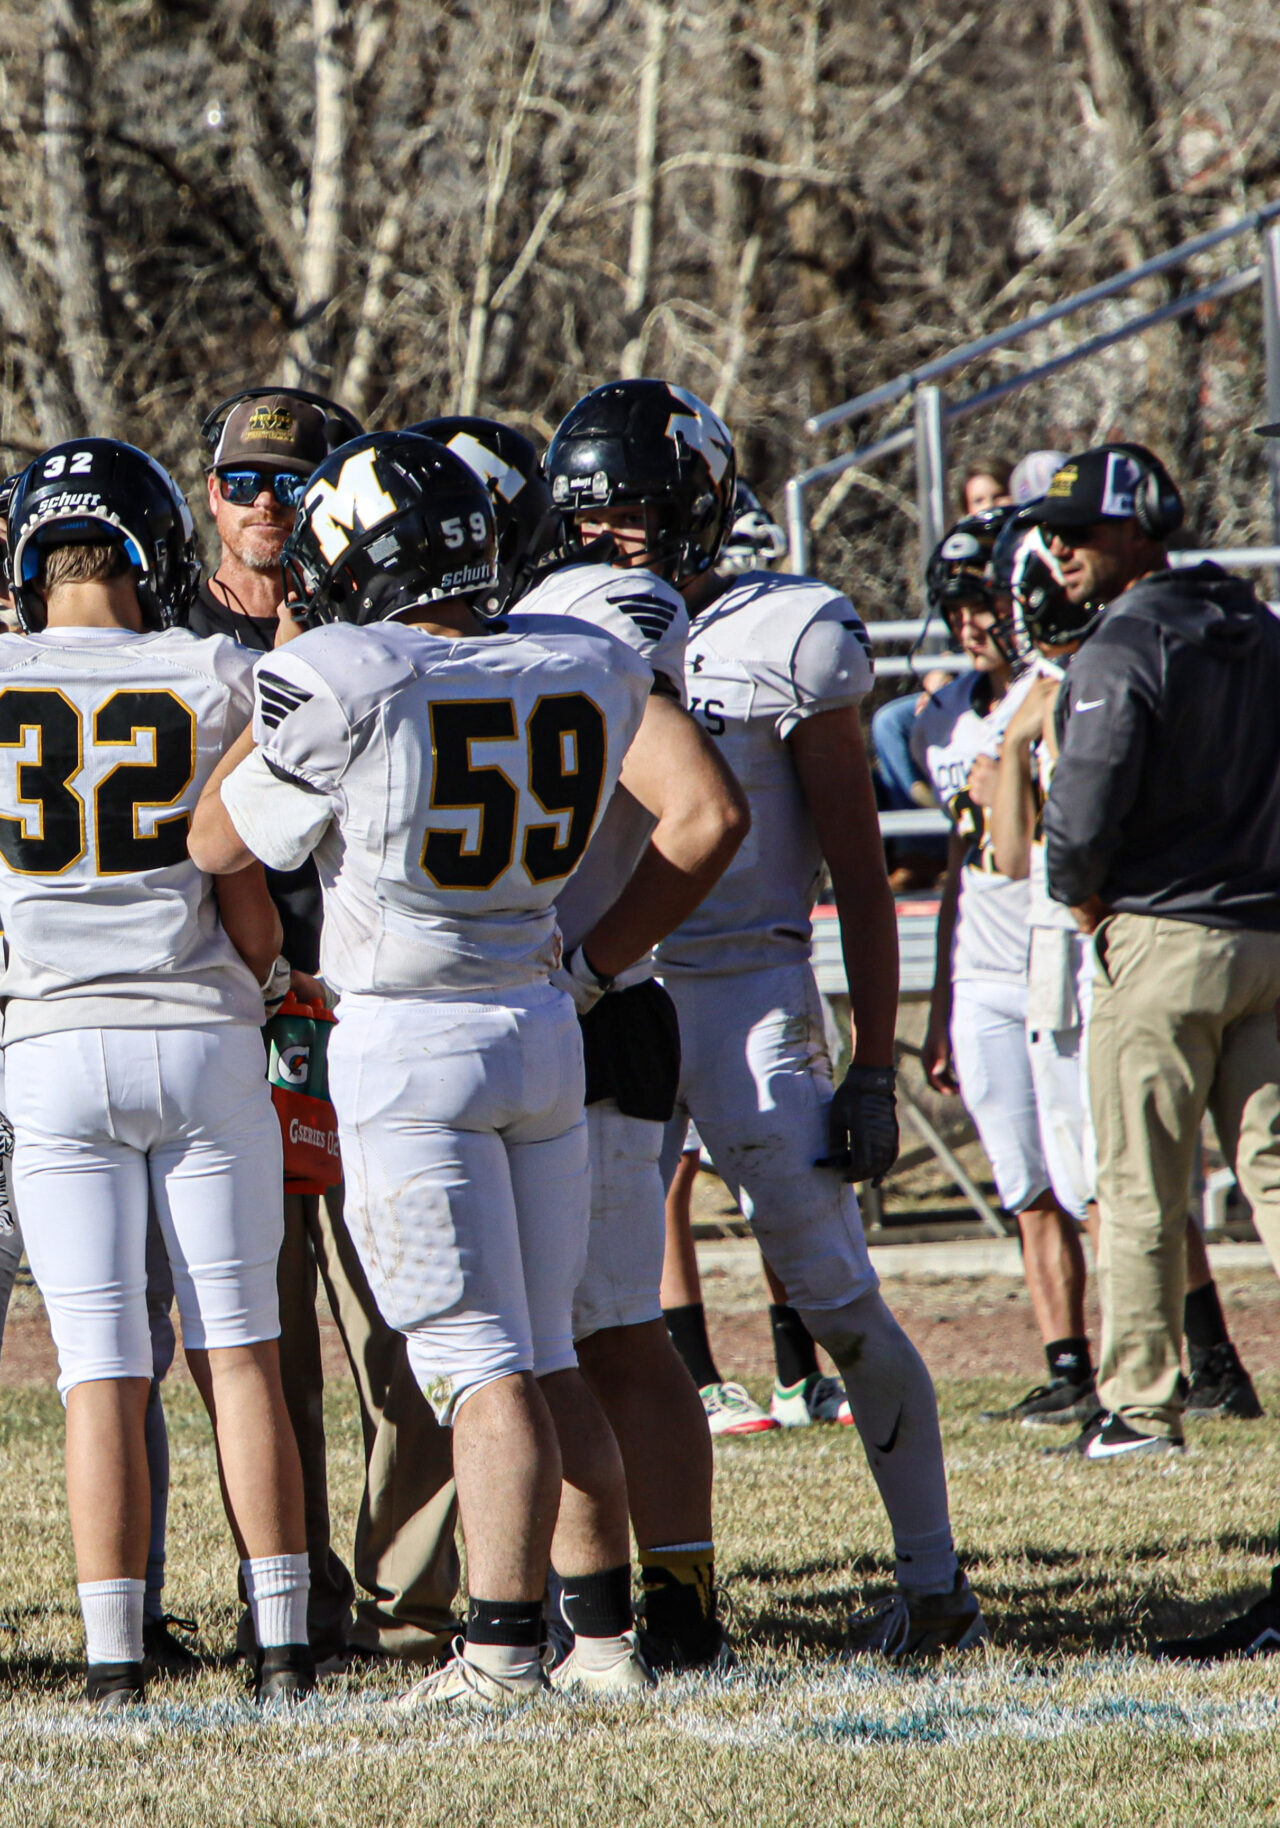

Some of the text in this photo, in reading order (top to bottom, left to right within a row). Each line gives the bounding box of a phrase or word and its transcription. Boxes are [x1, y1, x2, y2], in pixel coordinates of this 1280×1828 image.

[43, 451, 94, 479] 32
[304, 447, 398, 566] M
[440, 512, 488, 549] 59
[418, 690, 608, 891] 59
